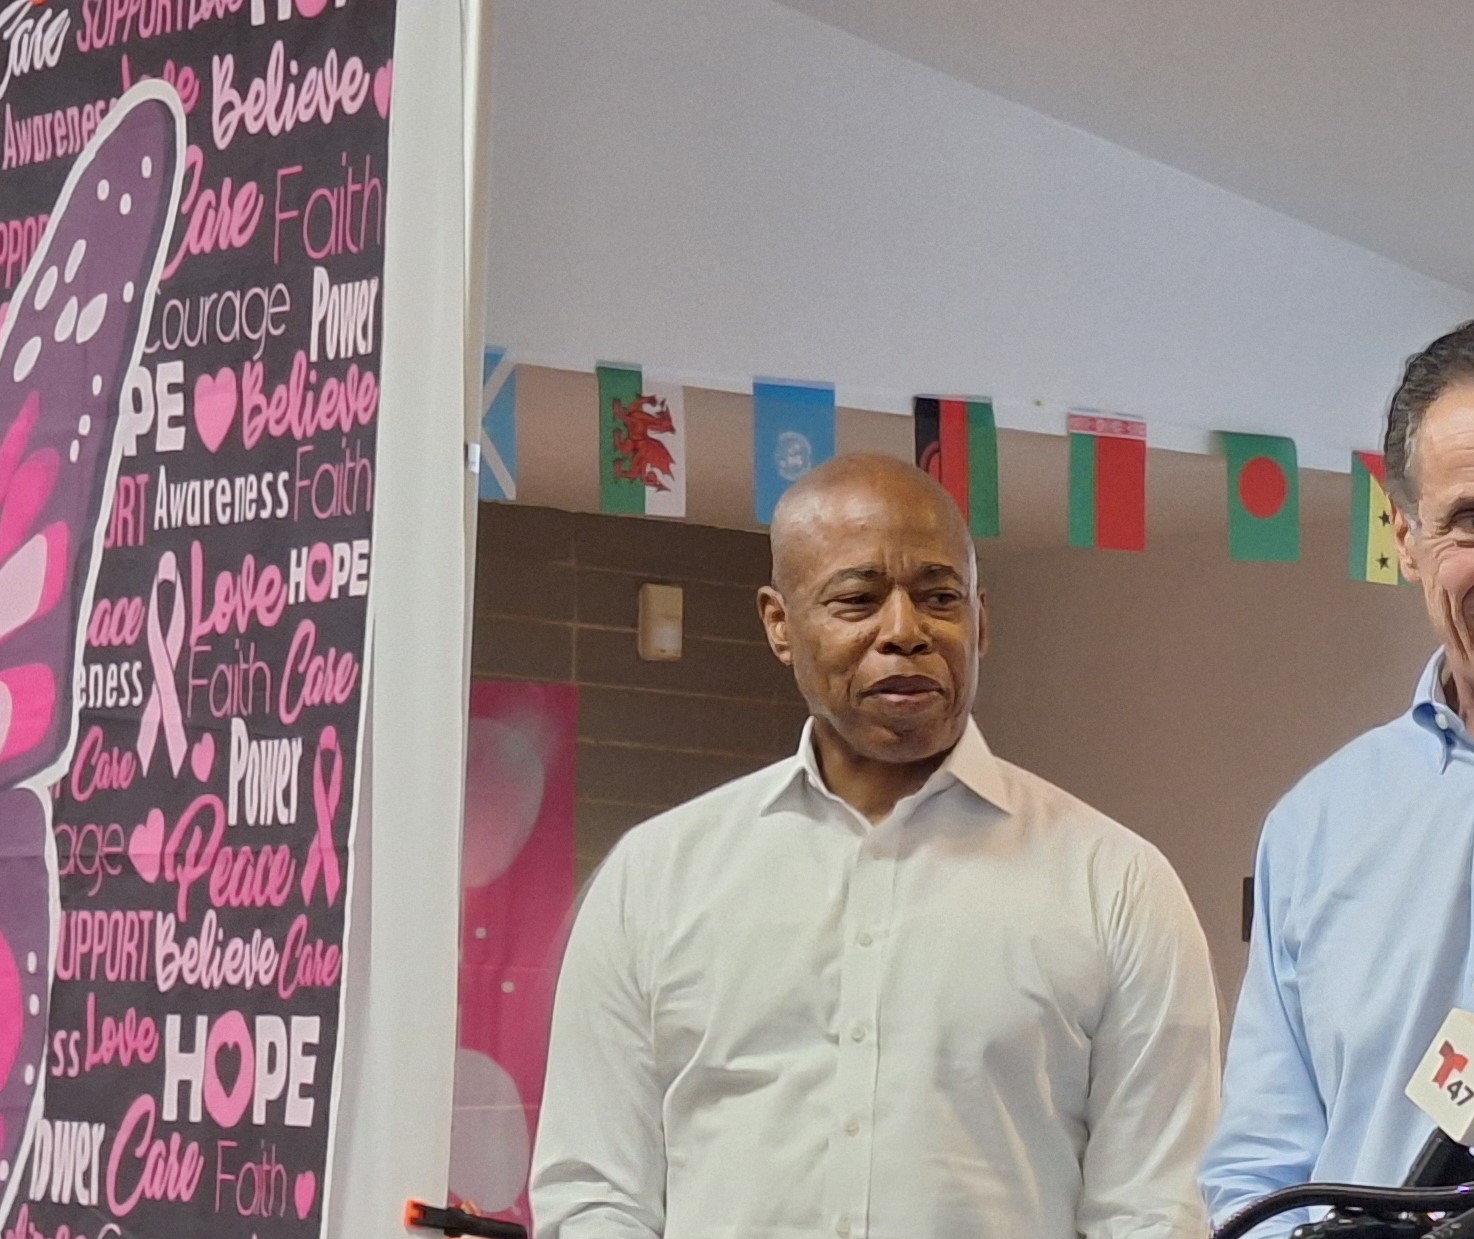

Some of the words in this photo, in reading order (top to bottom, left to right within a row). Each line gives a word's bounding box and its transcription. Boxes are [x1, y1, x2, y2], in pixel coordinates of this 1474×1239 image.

[2, 99, 117, 170] Awarene
[211, 40, 370, 150] Believe
[273, 152, 382, 264] Faith
[310, 266, 379, 362] Power
[123, 361, 186, 457] PE
[241, 350, 379, 450] Believe
[153, 465, 289, 531] Awareness
[293, 437, 372, 522] Faith
[87, 596, 146, 648] ace
[189, 540, 289, 647] Love
[288, 539, 370, 604] HOPE
[77, 660, 143, 709] eness
[187, 638, 271, 718] Faith
[278, 619, 359, 725] Care
[71, 726, 137, 802] Care
[227, 717, 303, 826] Power
[164, 793, 296, 922] Peace
[56, 910, 154, 982] UPPORT
[155, 909, 279, 992] Believe
[277, 914, 343, 999] Care
[84, 992, 159, 1072] Love
[162, 1010, 320, 1128] HOPE
[29, 1118, 106, 1207] ower
[106, 1093, 204, 1217] Care
[215, 1139, 288, 1218] Faith
